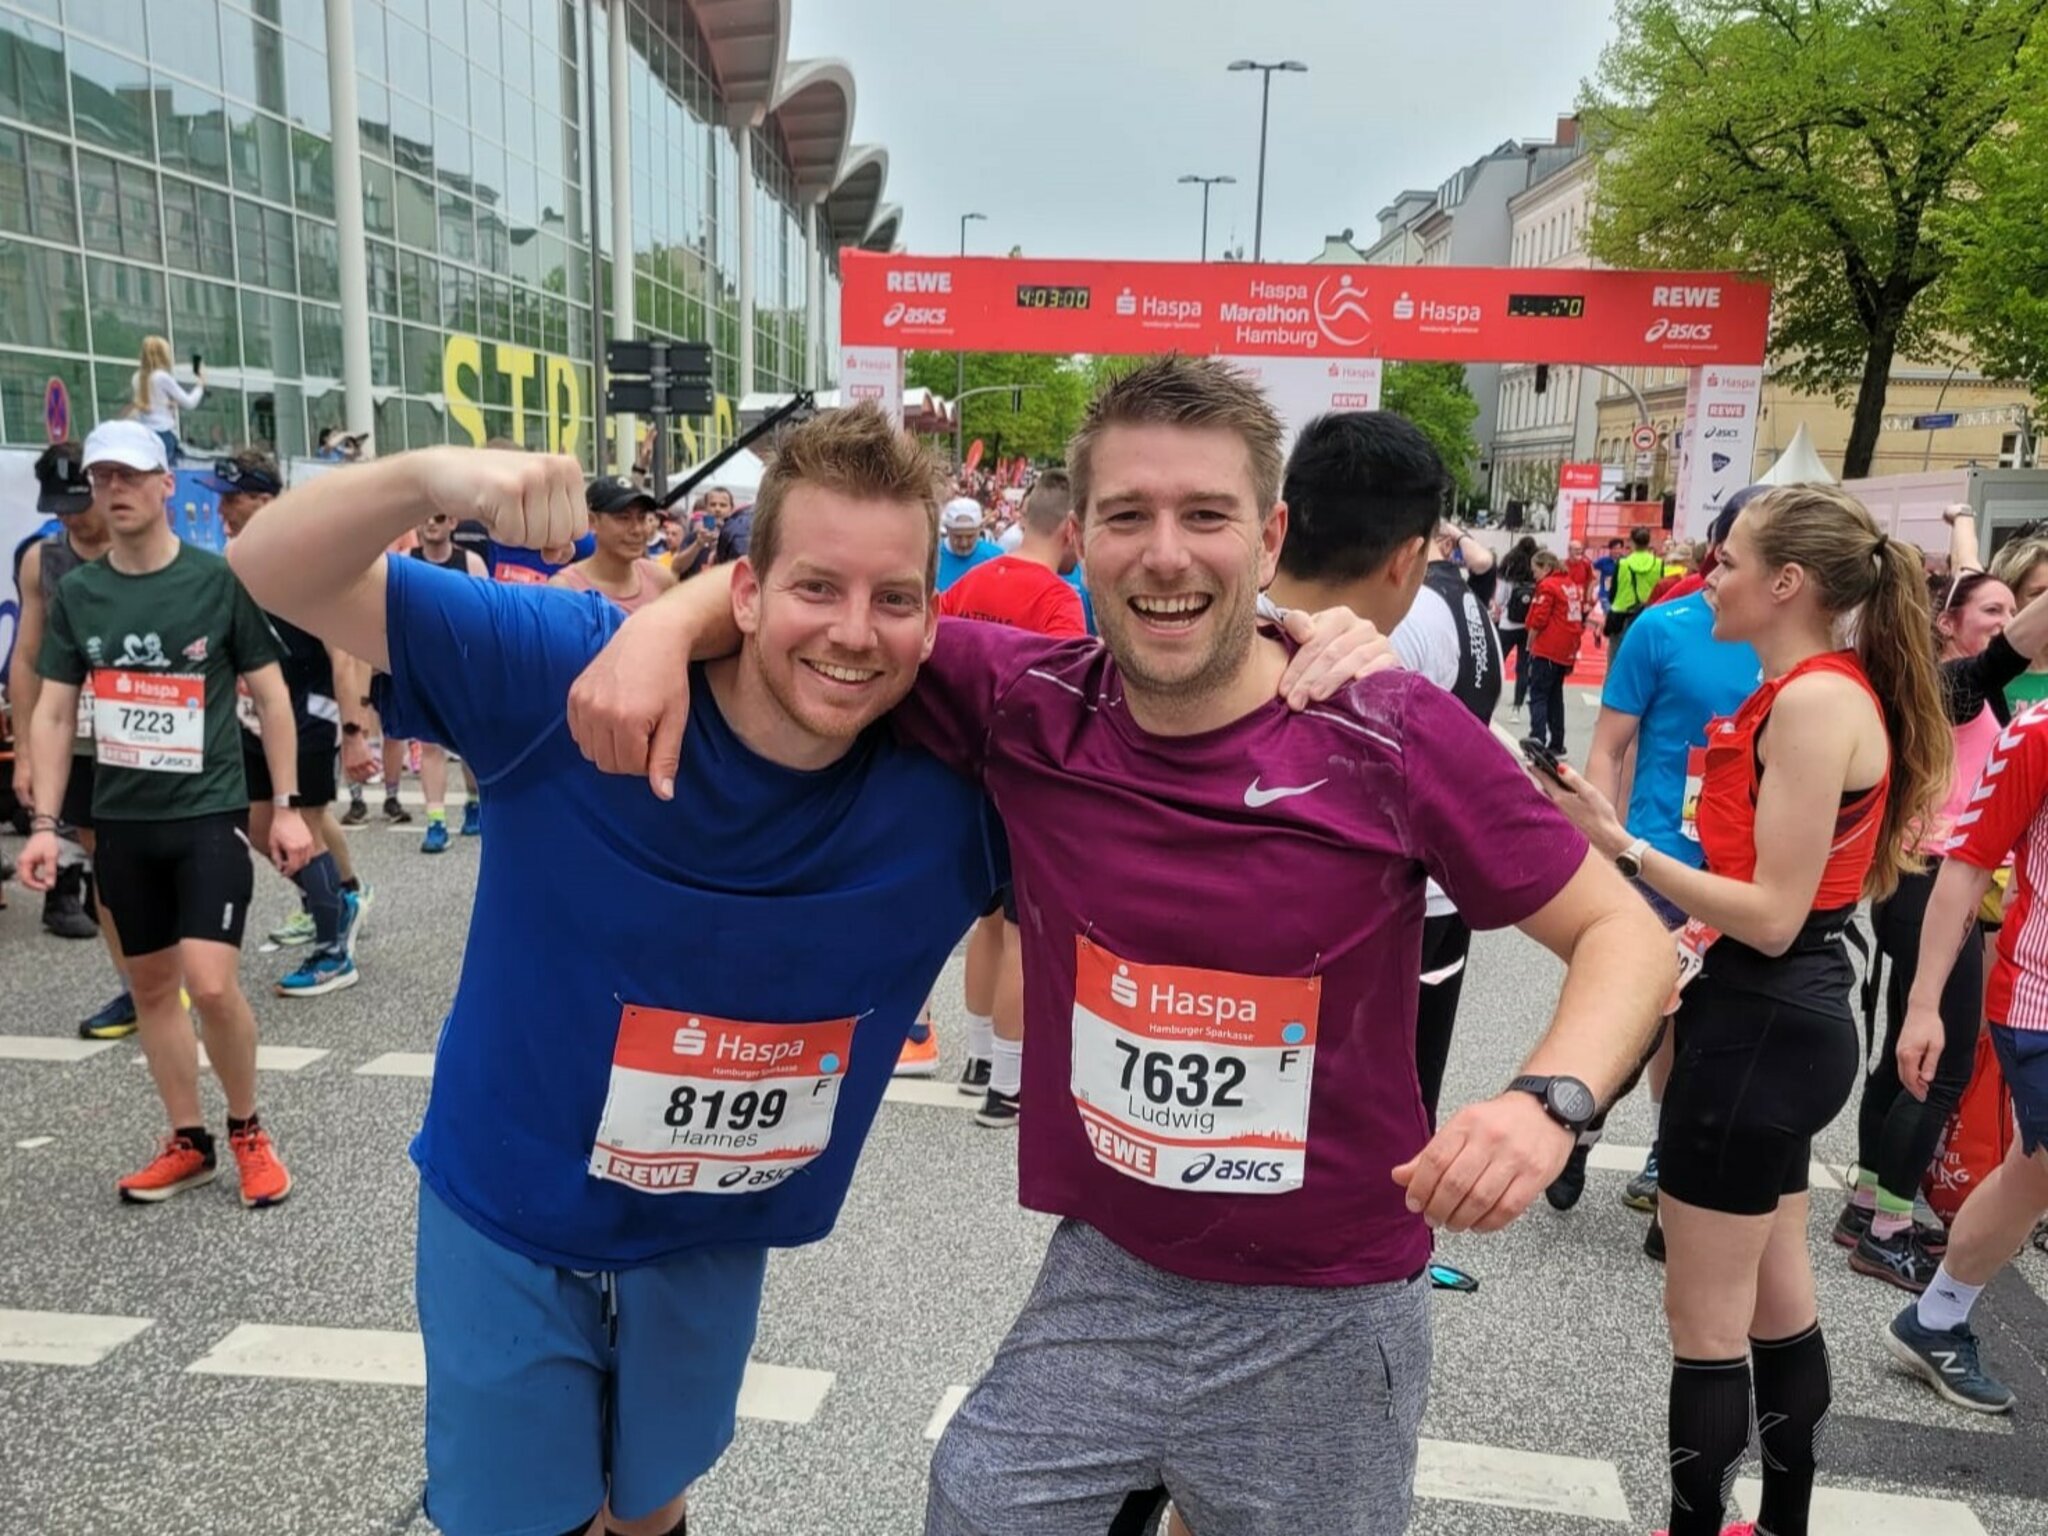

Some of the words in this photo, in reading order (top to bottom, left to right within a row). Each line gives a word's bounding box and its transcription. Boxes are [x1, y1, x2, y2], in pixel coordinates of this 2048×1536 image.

[887, 271, 952, 293] REWE
[1250, 281, 1308, 303] Haspa
[1142, 295, 1202, 320] Haspa
[1652, 286, 1722, 308] REWE
[1220, 303, 1310, 324] Marathon
[1420, 301, 1481, 325] Haspa
[1236, 326, 1319, 349] Hamburg
[1721, 377, 1756, 389] Haspa
[1709, 405, 1744, 417] REWE
[133, 679, 180, 699] Haspa
[119, 707, 175, 736] 7223
[1149, 984, 1257, 1025] Haspa
[1149, 1023, 1203, 1037] Hamburger
[1205, 1027, 1256, 1042] Sparkasse
[716, 1033, 805, 1067] Haspa
[713, 1066, 760, 1078] Hamburger
[1280, 1050, 1300, 1073] F
[1116, 1039, 1247, 1108] 7632
[812, 1078, 832, 1097] F
[664, 1086, 788, 1131] 8199
[1128, 1094, 1216, 1134] Ludwig
[671, 1127, 759, 1148] Hannes
[610, 1157, 694, 1186] REWE
